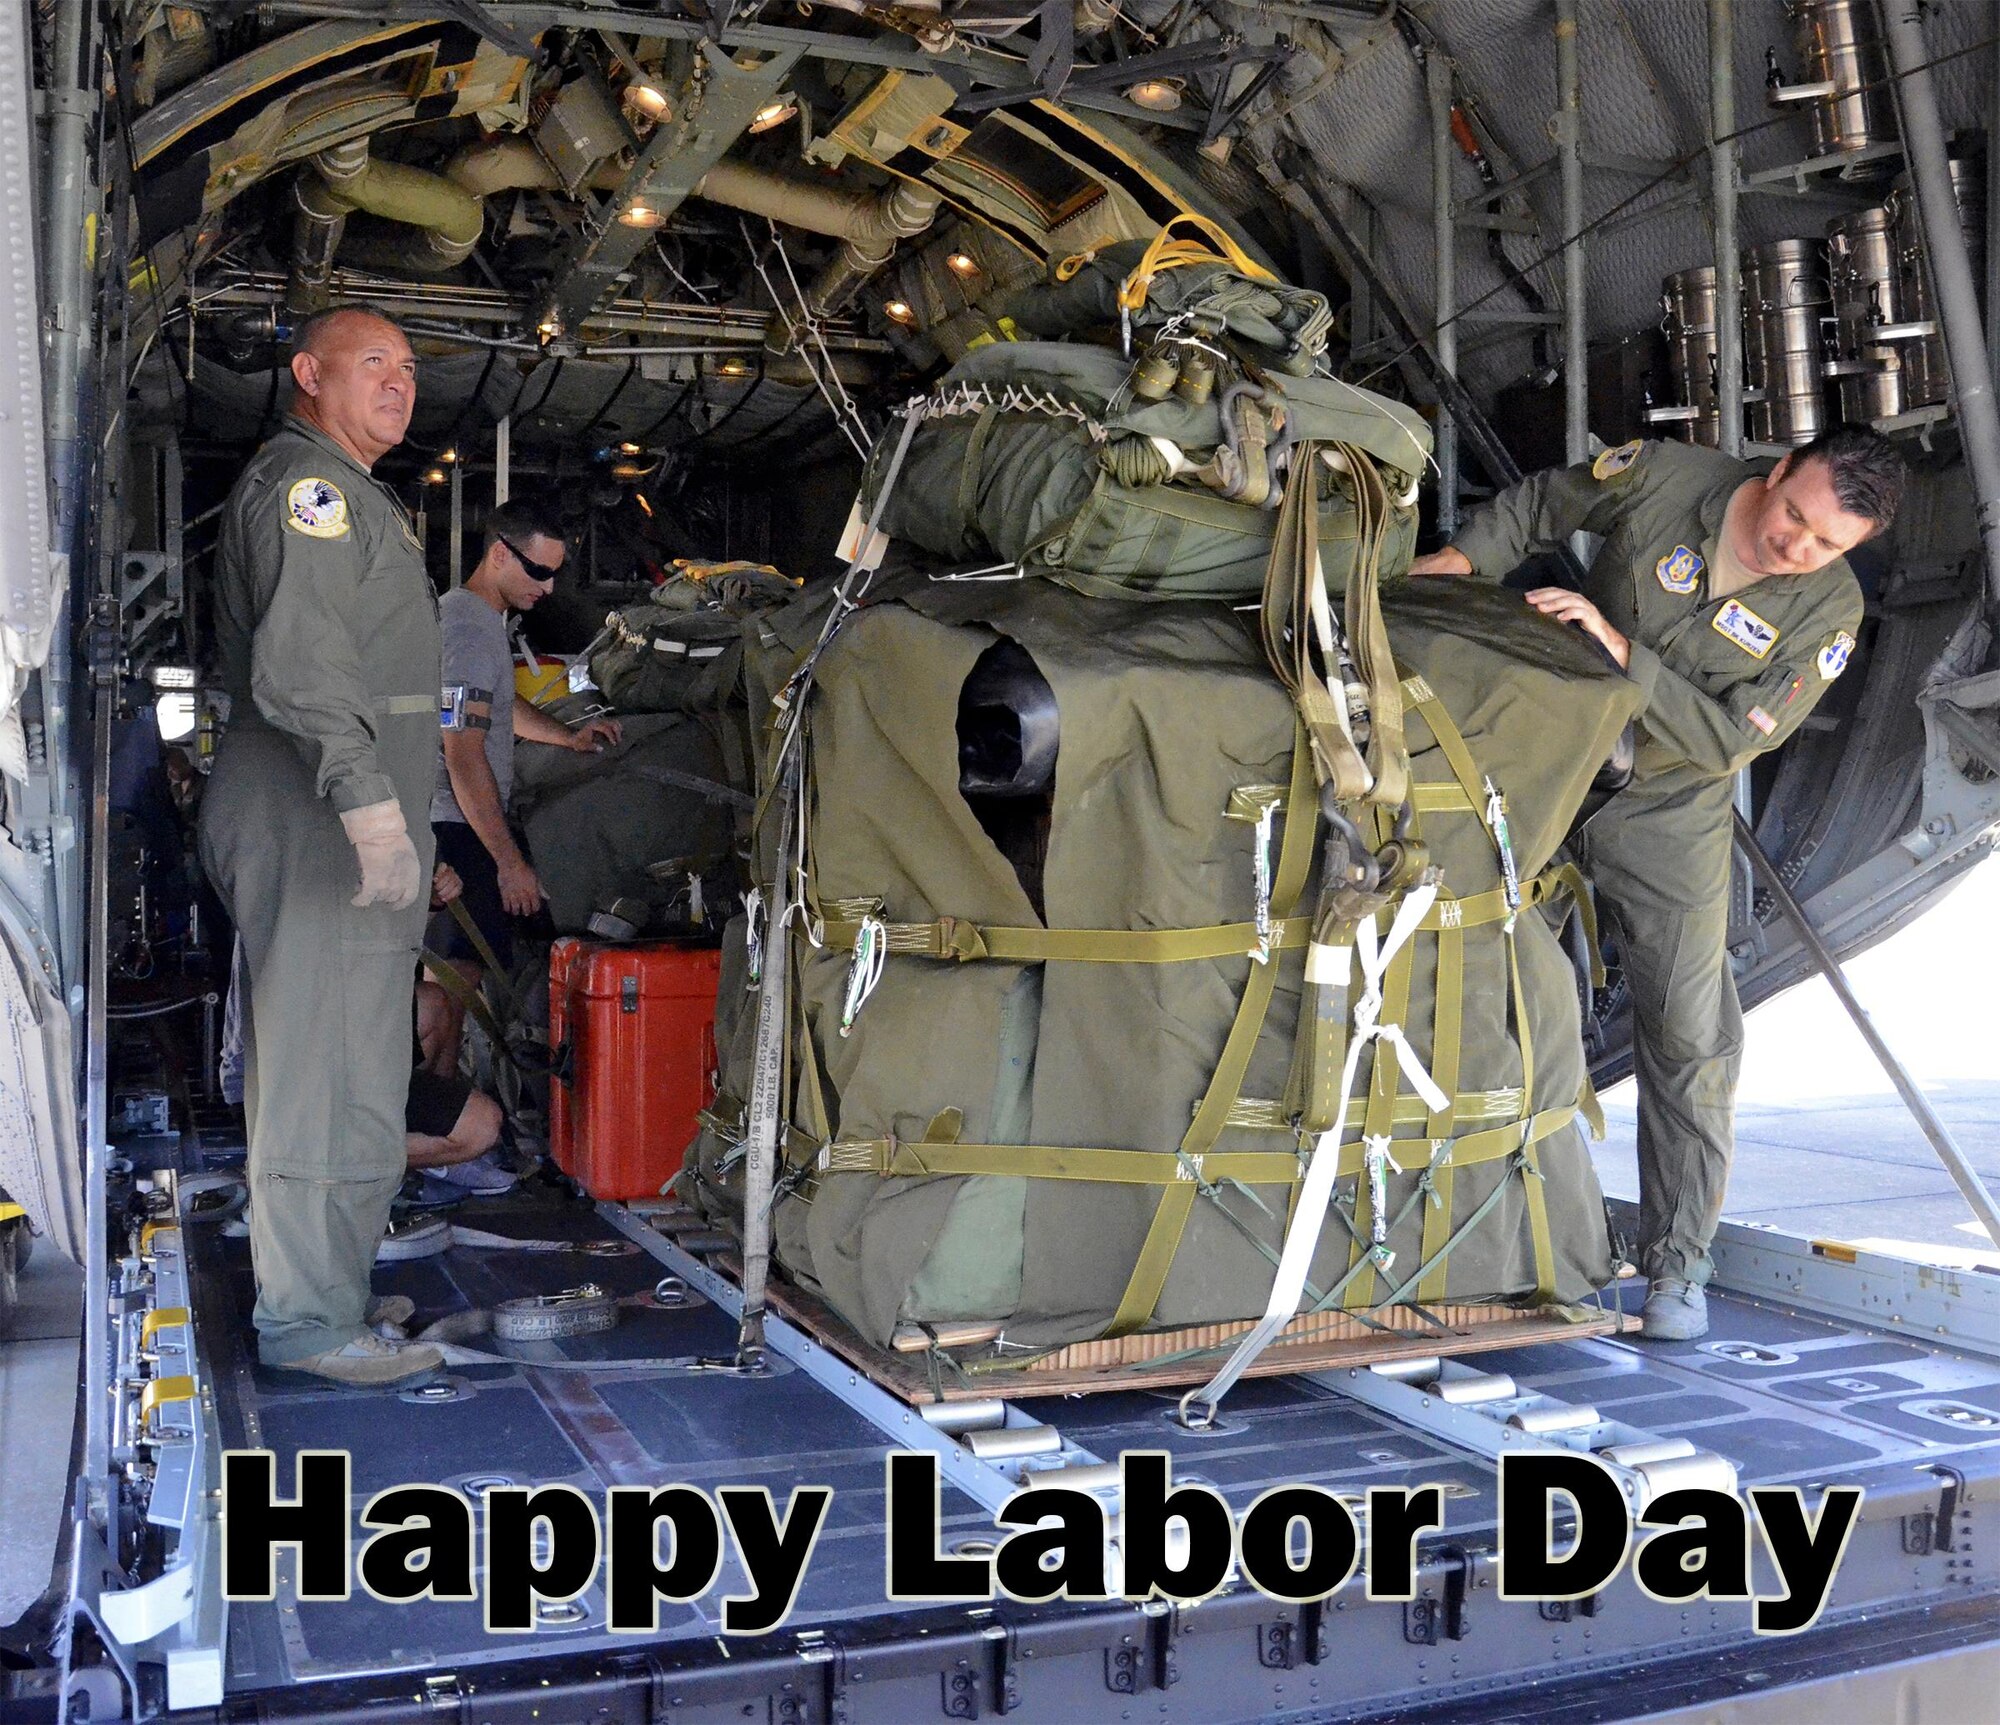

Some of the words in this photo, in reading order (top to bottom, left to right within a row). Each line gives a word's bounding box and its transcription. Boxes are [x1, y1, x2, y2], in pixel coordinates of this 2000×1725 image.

[753, 1102, 763, 1122] CL2
[766, 1093, 776, 1119] 5000
[750, 1125, 761, 1170] CGU-1/B
